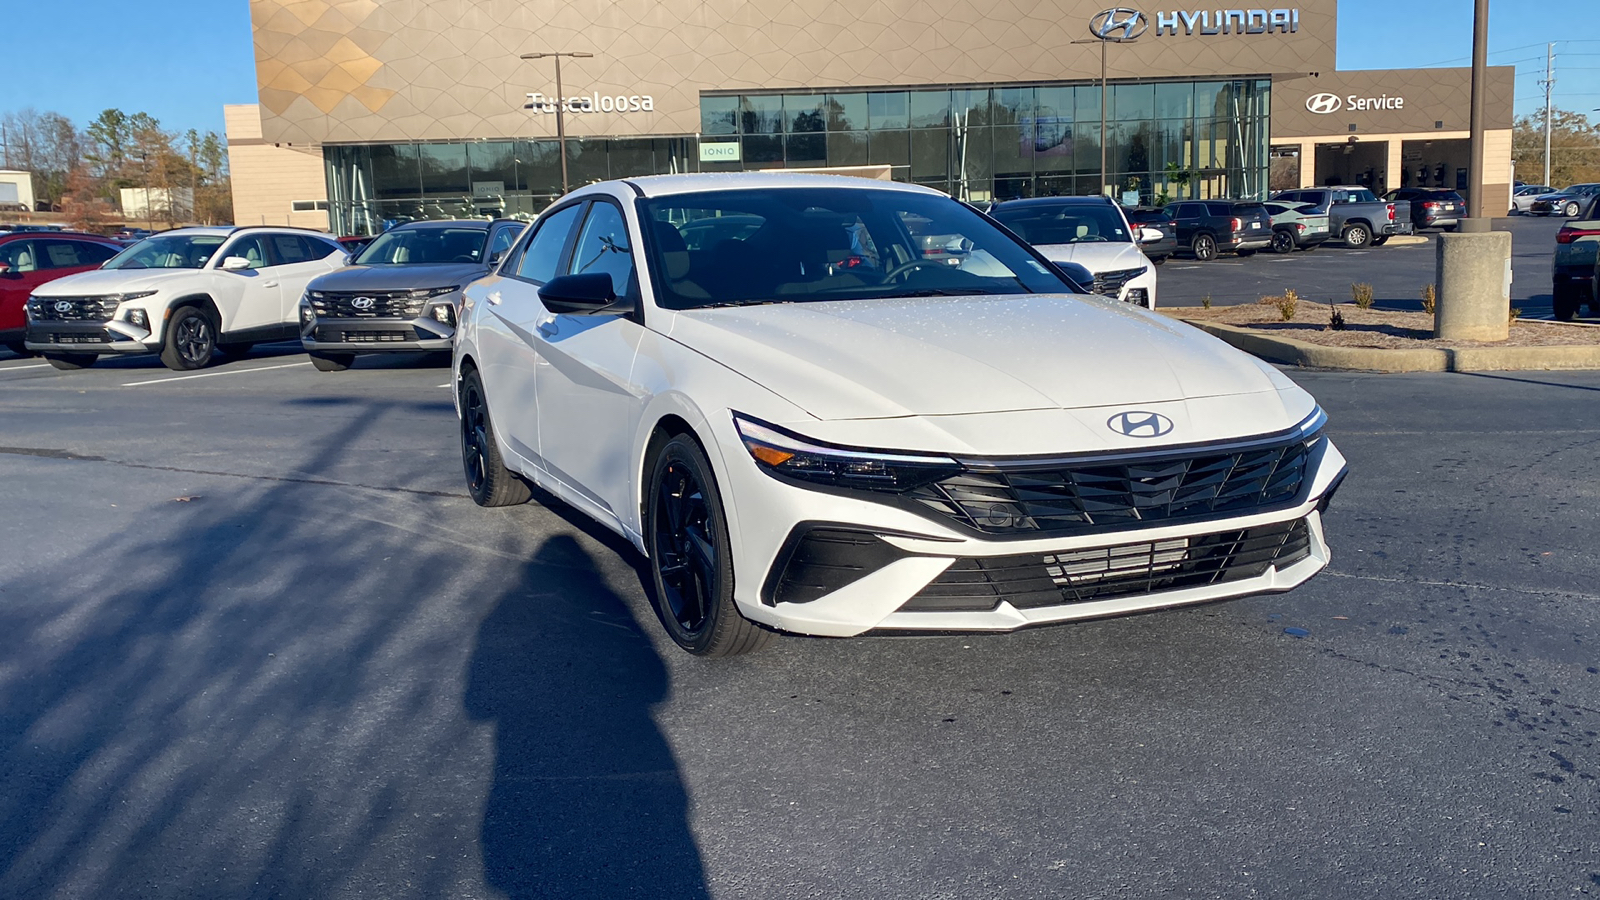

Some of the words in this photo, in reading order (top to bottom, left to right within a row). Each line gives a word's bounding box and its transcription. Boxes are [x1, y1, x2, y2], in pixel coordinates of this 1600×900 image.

[1156, 8, 1299, 36] HYUNDAI
[526, 91, 654, 114] Tuscaloosa
[1346, 94, 1404, 111] Service
